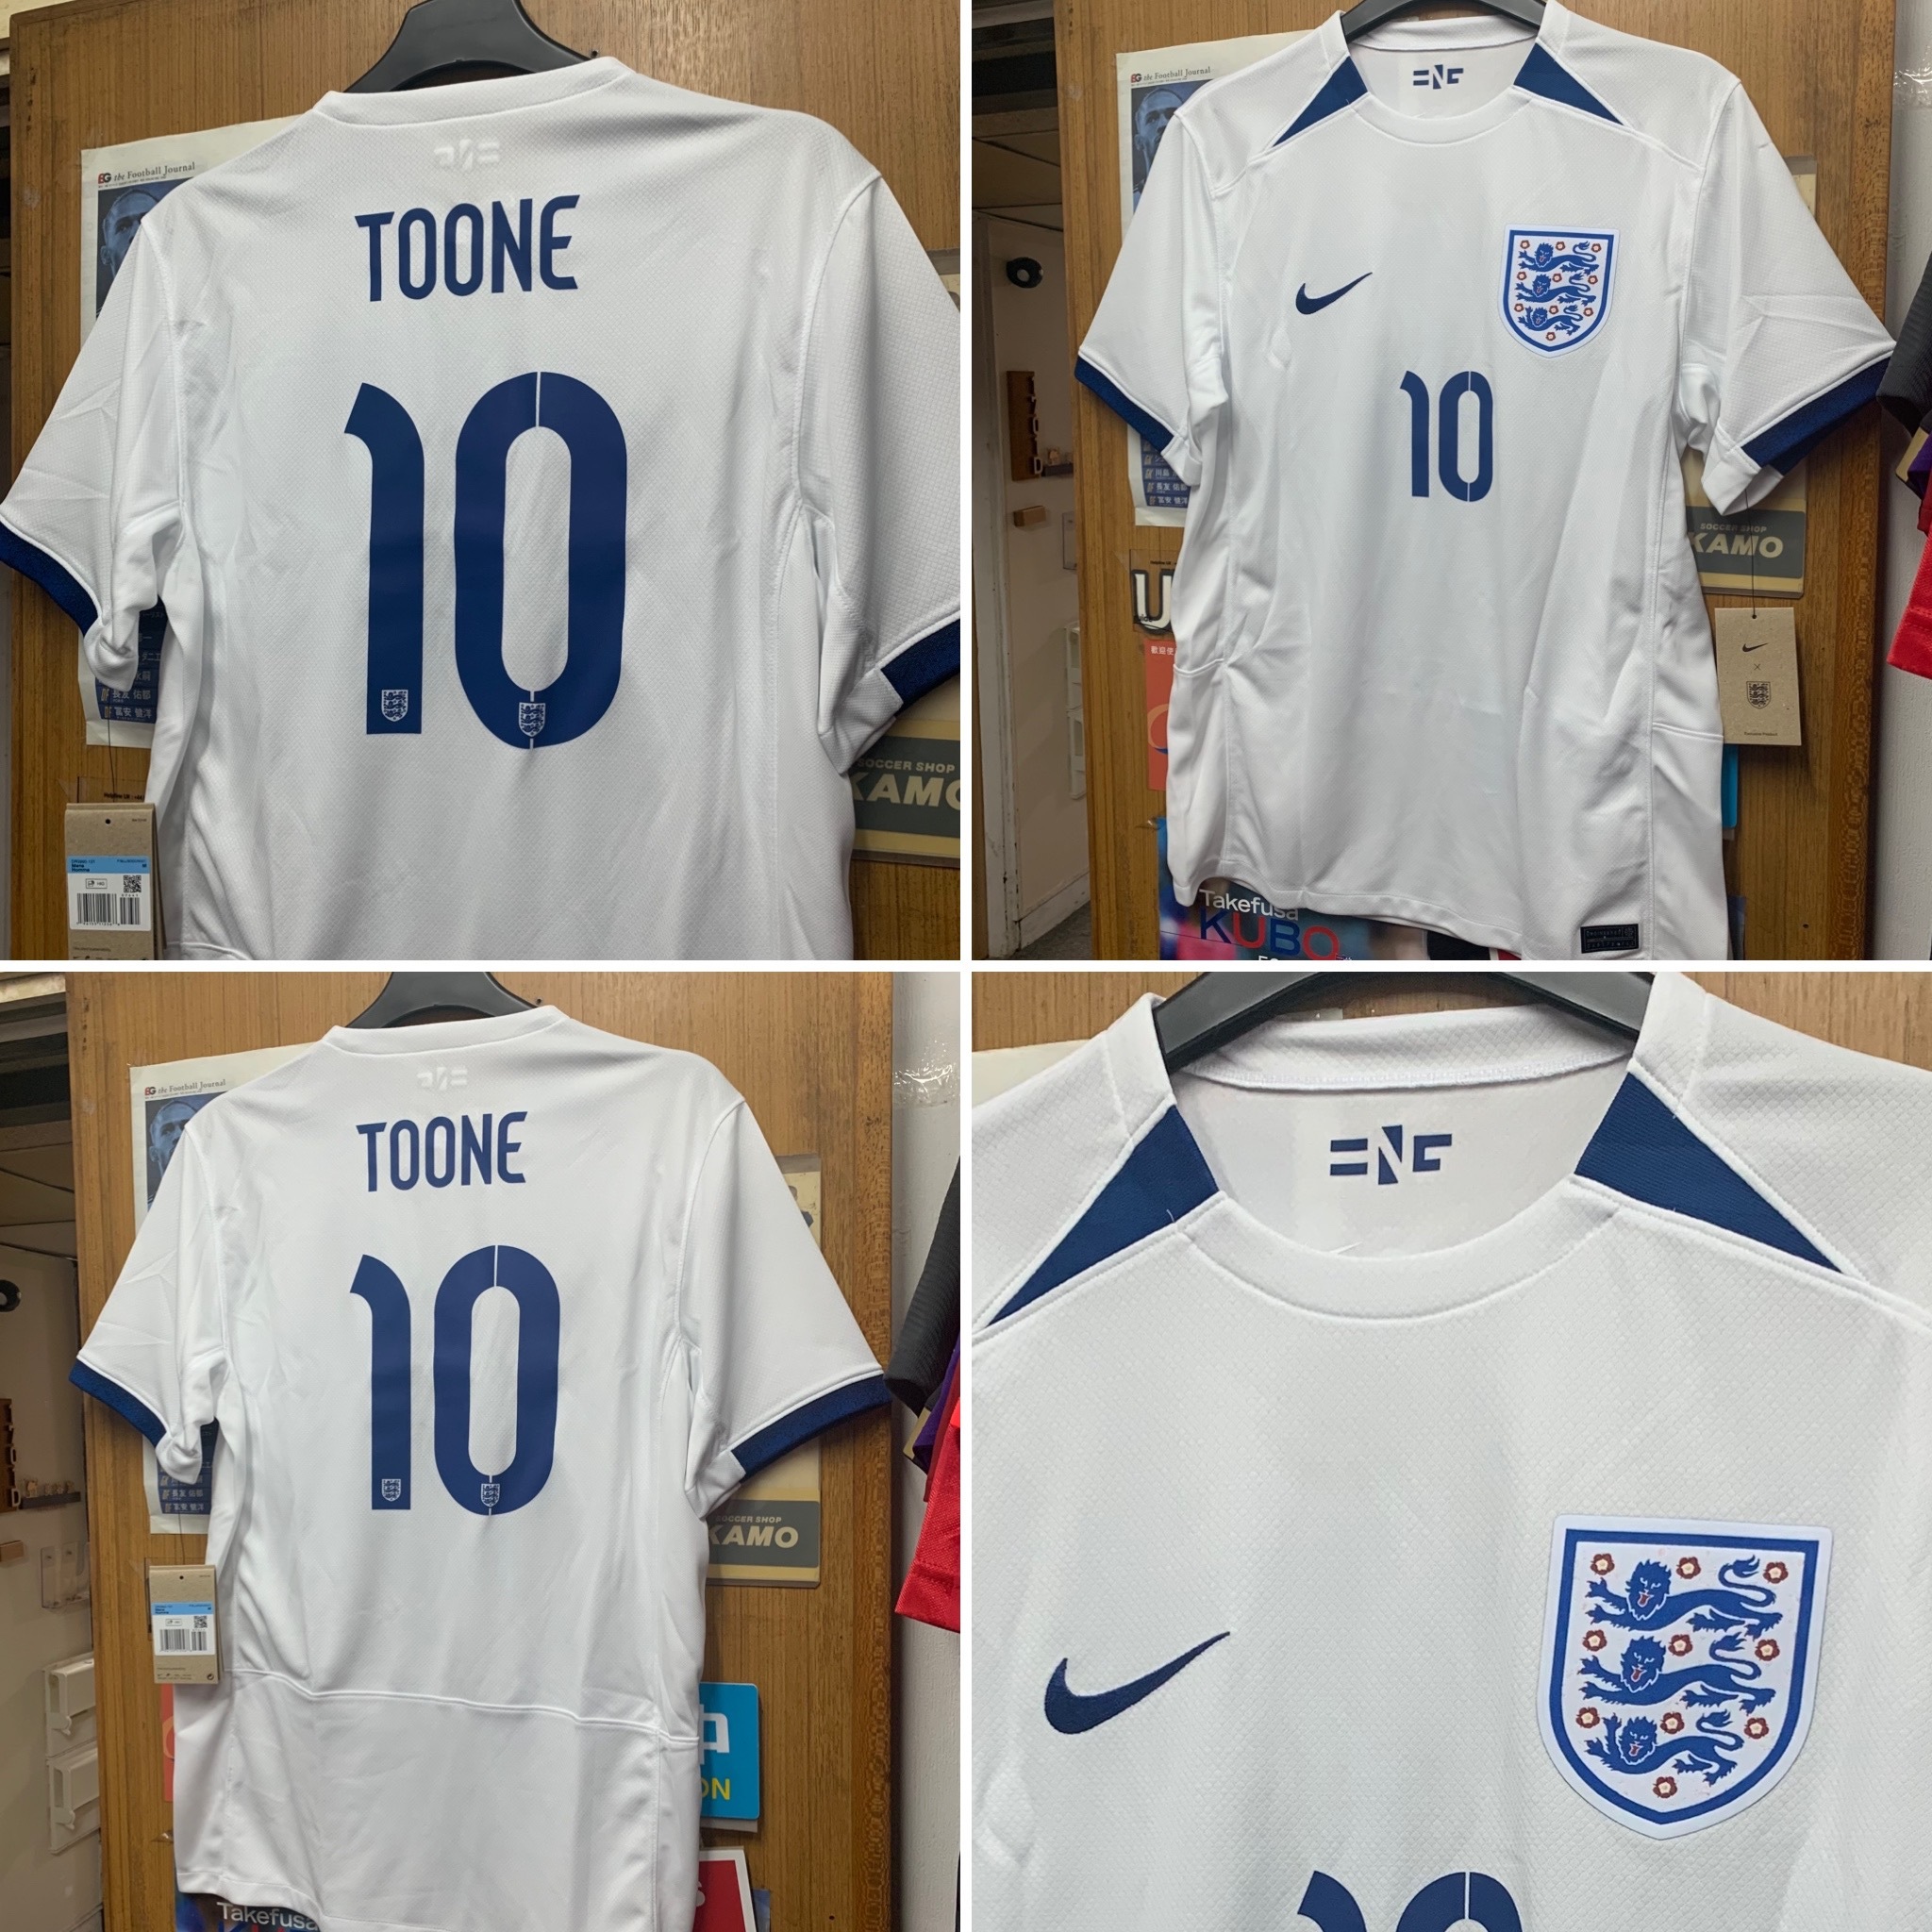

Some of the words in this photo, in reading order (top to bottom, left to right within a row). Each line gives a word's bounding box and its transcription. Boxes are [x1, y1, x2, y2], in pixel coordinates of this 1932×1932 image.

[1155, 69, 1183, 80] Football
[1185, 66, 1211, 78] Journal
[127, 167, 161, 179] Football
[163, 161, 195, 176] Journal
[355, 194, 580, 302] TOONE
[1400, 370, 1493, 502] 10
[1701, 523, 1739, 531] SOCCER
[1740, 525, 1767, 533] SHOP
[1688, 531, 1784, 558] KAMO
[344, 372, 628, 749] 10
[1151, 645, 1177, 656] 歡迎使
[858, 758, 912, 771] SOCCER
[916, 762, 956, 774] SHOP
[1199, 906, 1341, 960] KUBO
[169, 1082, 198, 1092] Football
[200, 1078, 226, 1091] Journal
[356, 1111, 528, 1191] TOONE
[350, 1245, 560, 1516] 10
